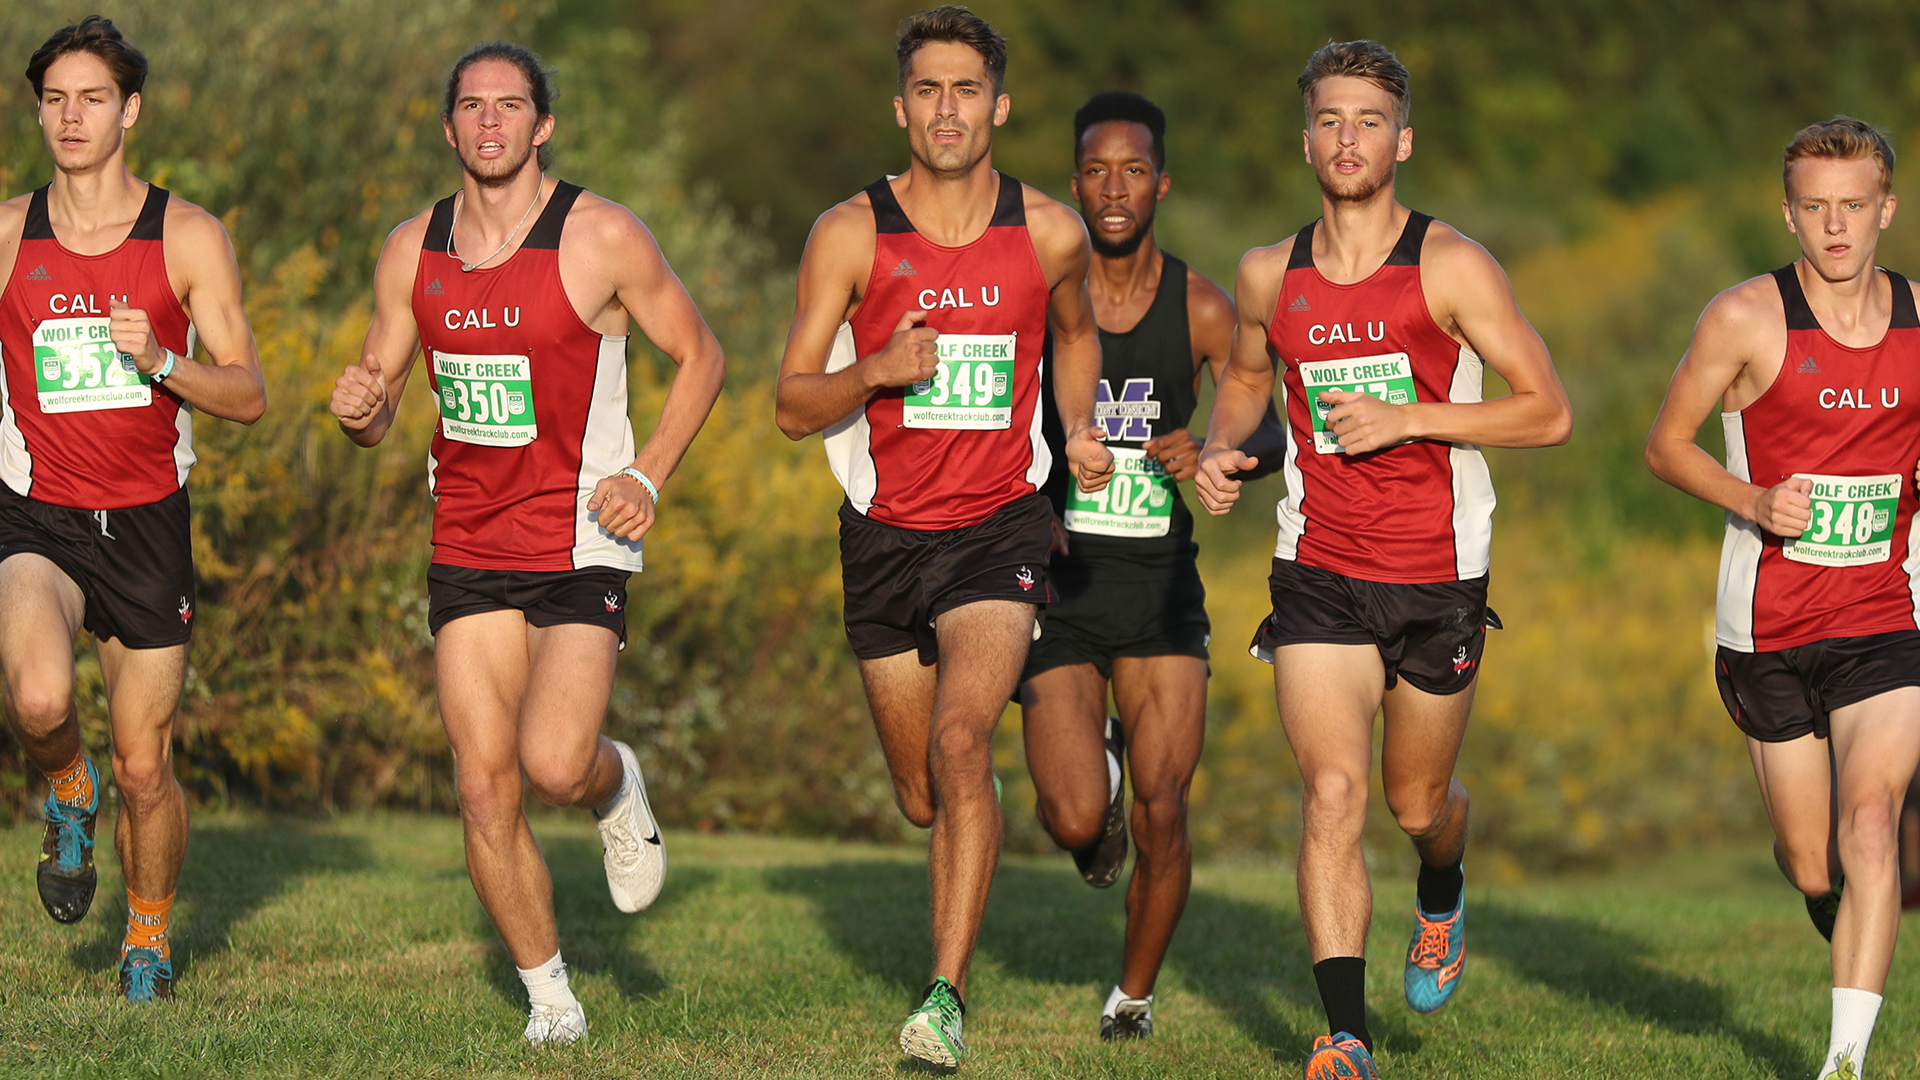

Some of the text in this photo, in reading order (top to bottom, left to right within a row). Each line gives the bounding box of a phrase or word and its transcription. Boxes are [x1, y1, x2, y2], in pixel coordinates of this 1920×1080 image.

[49, 293, 102, 314] CAL
[918, 285, 1000, 310] CAL U
[445, 306, 520, 330] CAL U
[41, 326, 84, 342] WOLF
[1308, 320, 1385, 345] CAL U
[936, 344, 1008, 358] LF CREEK
[59, 343, 125, 389] 352
[439, 359, 522, 377] WOLF CREEK
[1310, 361, 1402, 383] WOLF CREEK
[930, 362, 994, 406] 349
[47, 391, 143, 405] wolfcreektrackclub.com
[453, 380, 510, 424] 350
[1818, 387, 1900, 409] CAL U
[914, 411, 1005, 422] wolfcreektrackclub.com
[449, 424, 529, 439] wolfcreektrackclub.com
[1810, 482, 1892, 498] OLF CREEK
[1073, 516, 1161, 530] wolfcreektrackclub.com
[1810, 501, 1875, 545] 348
[1793, 545, 1882, 559] wolfcreektrackclub.com
